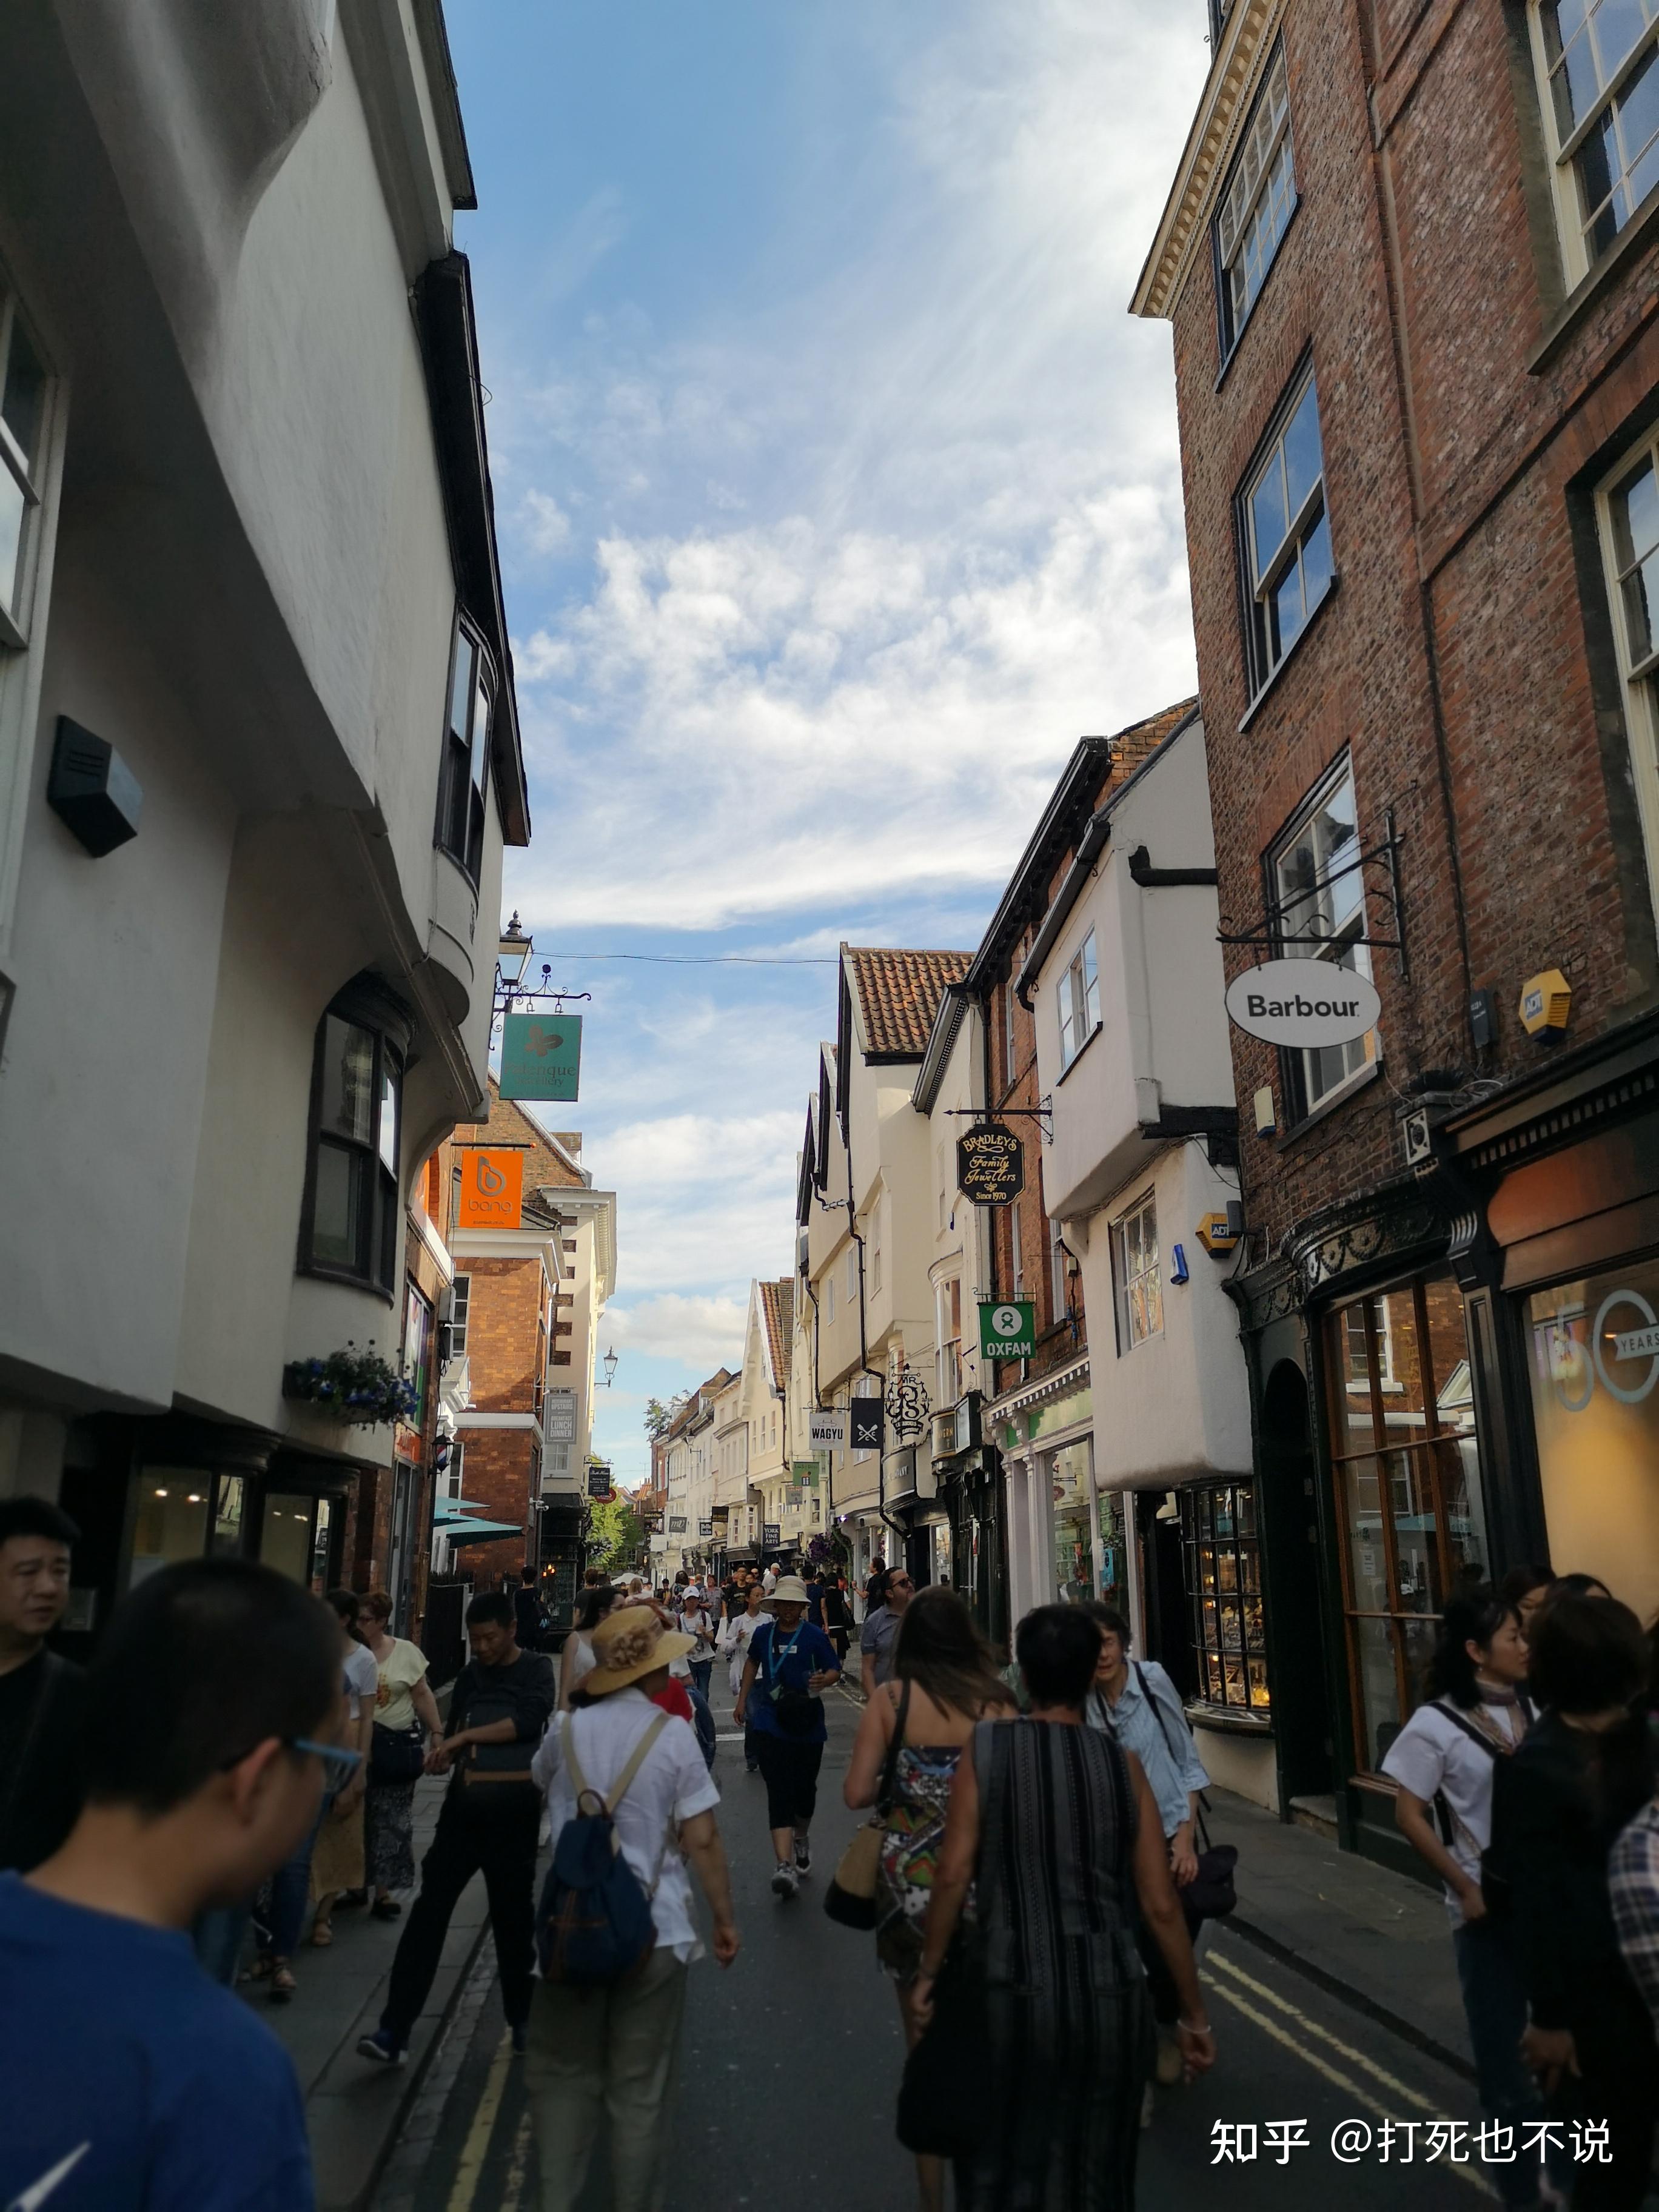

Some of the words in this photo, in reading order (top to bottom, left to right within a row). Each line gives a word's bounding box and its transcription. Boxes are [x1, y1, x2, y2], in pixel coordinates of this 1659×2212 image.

[1247, 994, 1359, 1017] Barbour
[1526, 993, 1542, 1014] ADT
[504, 1062, 577, 1079] Palenque
[962, 1134, 1017, 1153] BRADLEYS
[969, 1155, 1010, 1171] Family
[964, 1168, 1016, 1185] Jewellers
[992, 1192, 1007, 1201] 1970
[469, 1198, 512, 1215] bang
[1212, 1226, 1230, 1236] ADT
[987, 1341, 1031, 1356] OXFAM
[1621, 1332, 1659, 1353] YEARS
[551, 1421, 572, 1430] LUNCH
[812, 1428, 843, 1439] WAGYU
